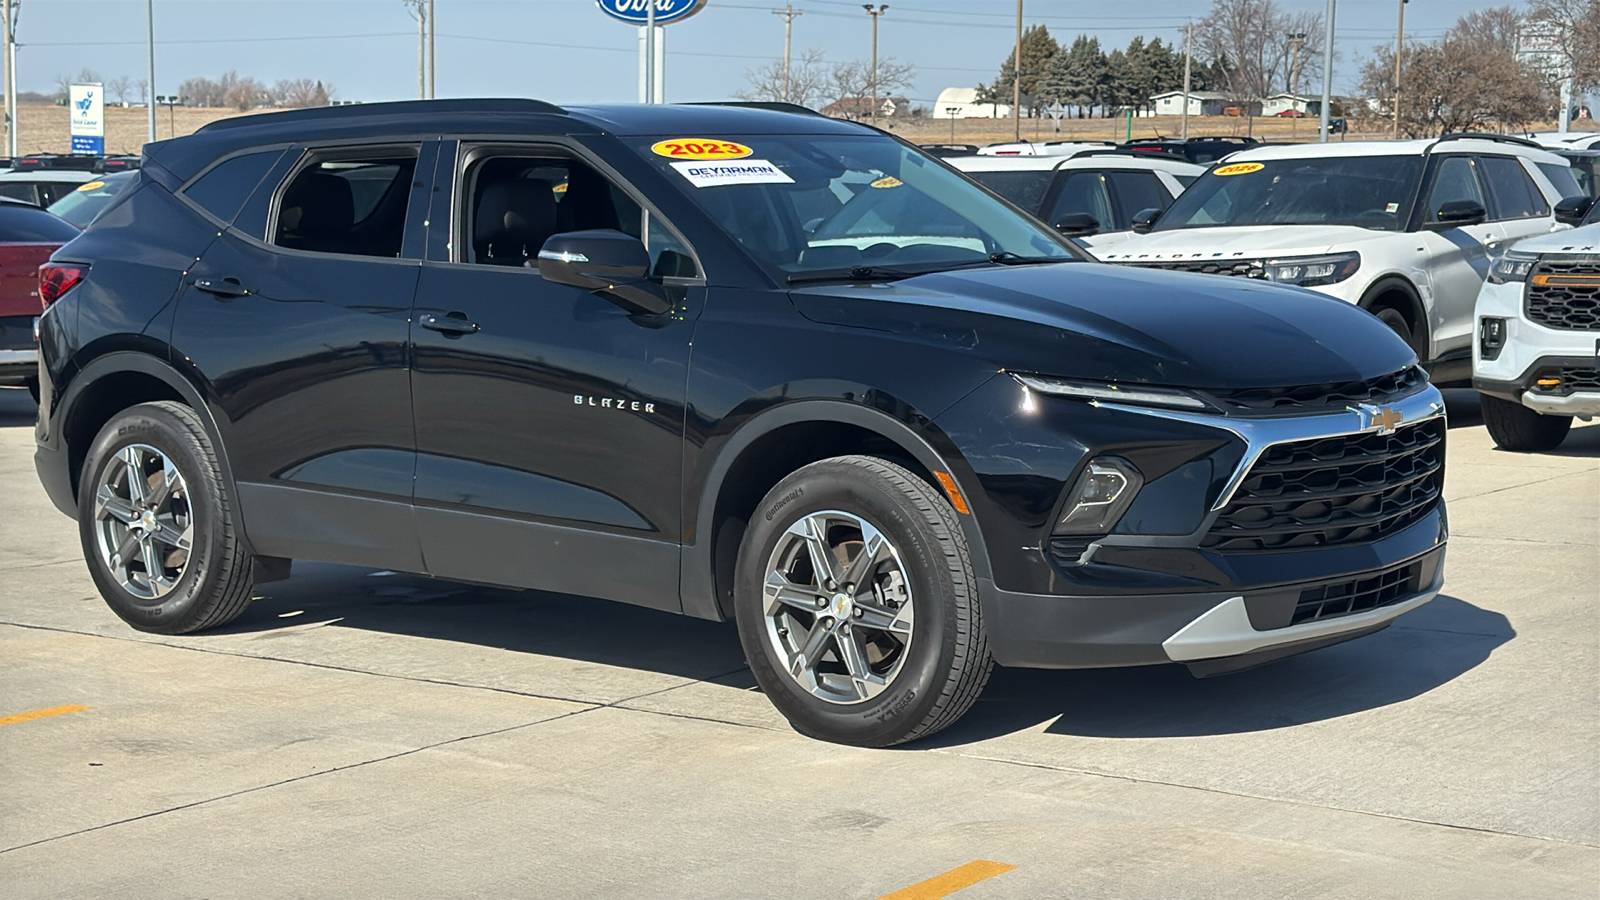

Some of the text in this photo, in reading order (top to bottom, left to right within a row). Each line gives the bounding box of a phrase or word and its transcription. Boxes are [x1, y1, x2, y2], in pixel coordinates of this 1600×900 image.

[665, 143, 744, 156] 2023
[687, 166, 774, 176] DEYARMAN
[574, 394, 655, 413] BLAZER
[765, 488, 800, 521] Continental
